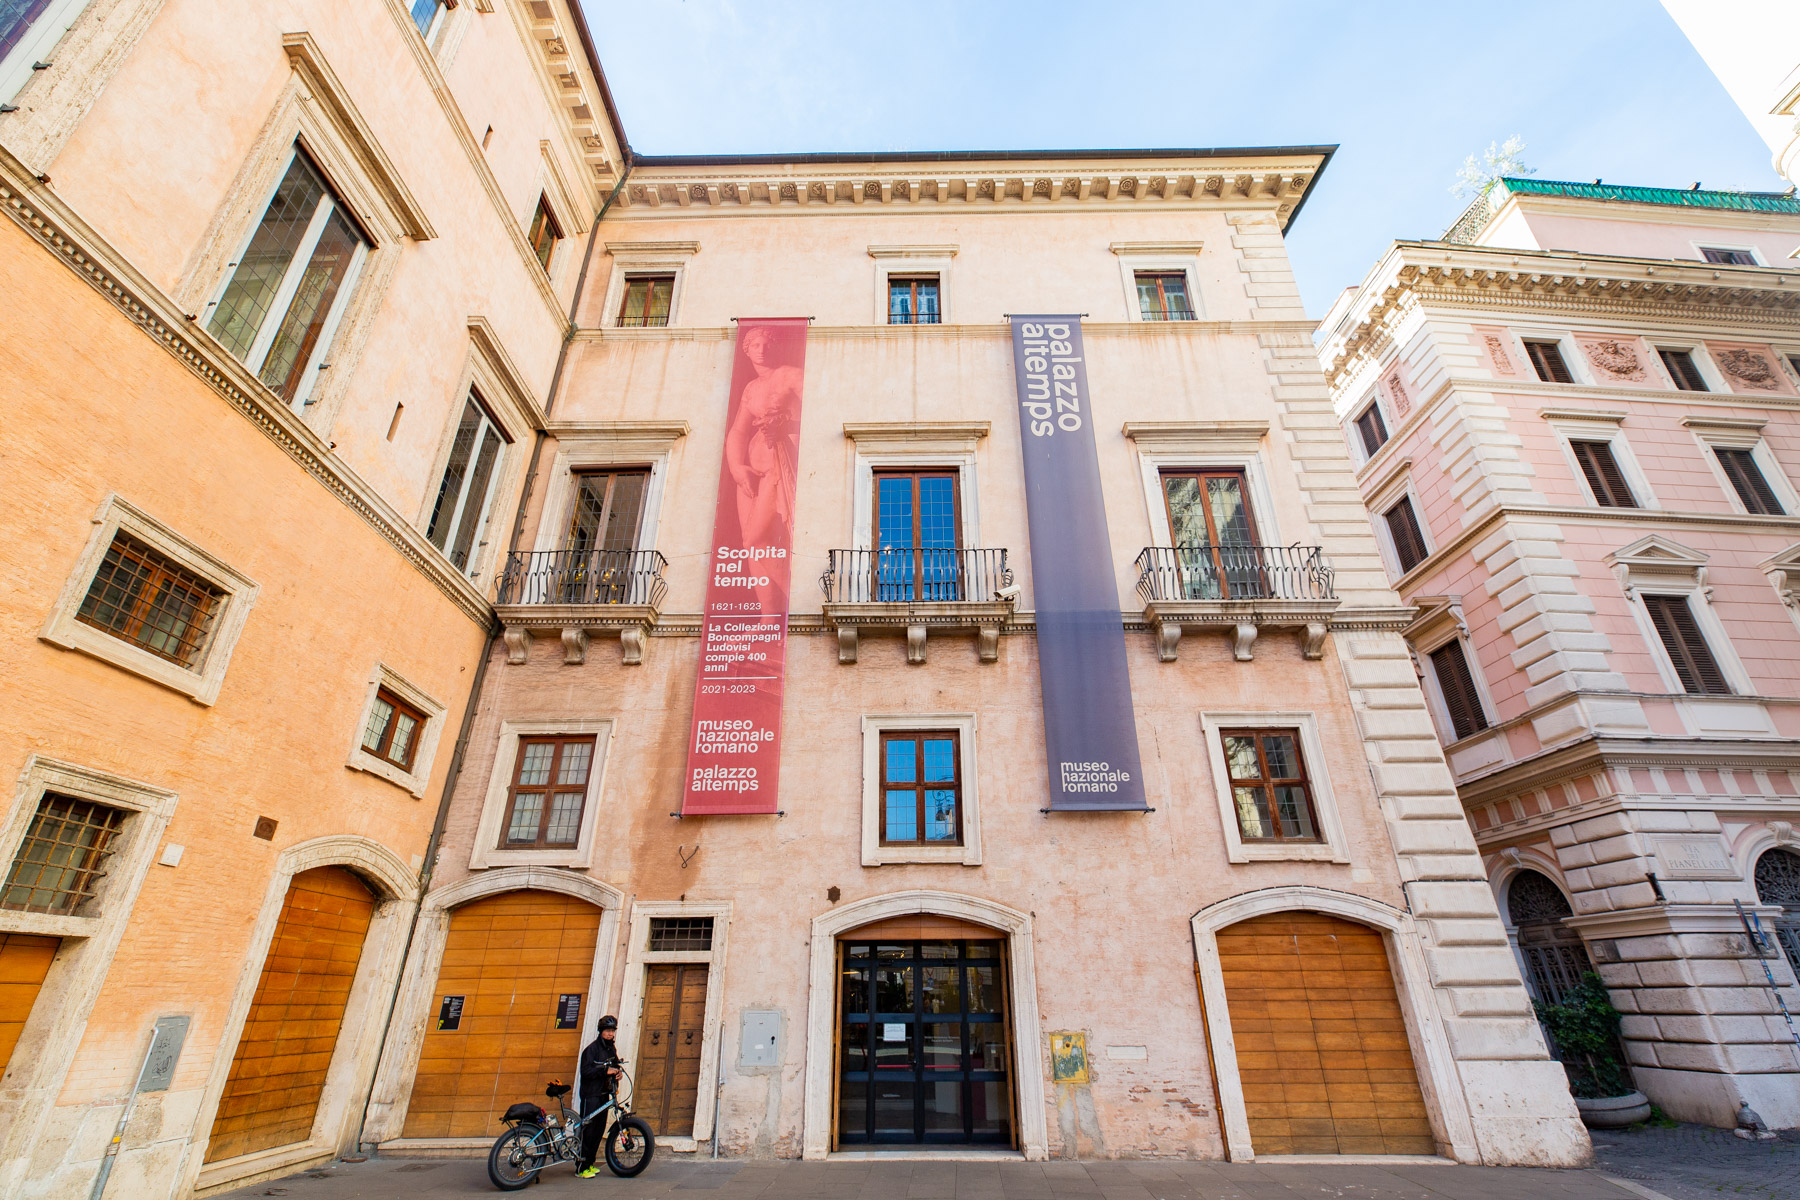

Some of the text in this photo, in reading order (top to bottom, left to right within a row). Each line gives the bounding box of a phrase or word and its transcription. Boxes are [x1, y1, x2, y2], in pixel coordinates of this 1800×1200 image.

[1021, 322, 1055, 437] altemps
[1044, 323, 1082, 432] palazzo
[716, 545, 787, 561] Scolpita
[715, 560, 743, 573] nel
[714, 574, 770, 590] tempo
[711, 602, 762, 611] 1621-1623
[708, 622, 780, 632] La Collezione
[707, 632, 781, 643] Boncompagni
[706, 642, 751, 652] Ludovisi
[705, 652, 767, 664] compie 400
[704, 662, 728, 672] anni
[701, 684, 756, 694] 2021-2023
[698, 719, 754, 731] museo
[697, 727, 775, 742] nazionale
[695, 742, 759, 754] romano
[693, 764, 757, 780] palazzo
[1060, 761, 1110, 772] museo
[1061, 768, 1131, 782] nazionale
[691, 778, 759, 794] altemps
[1062, 782, 1118, 793] romano
[1680, 844, 1700, 853] VIA
[1668, 859, 1728, 869] PIANELLARI
